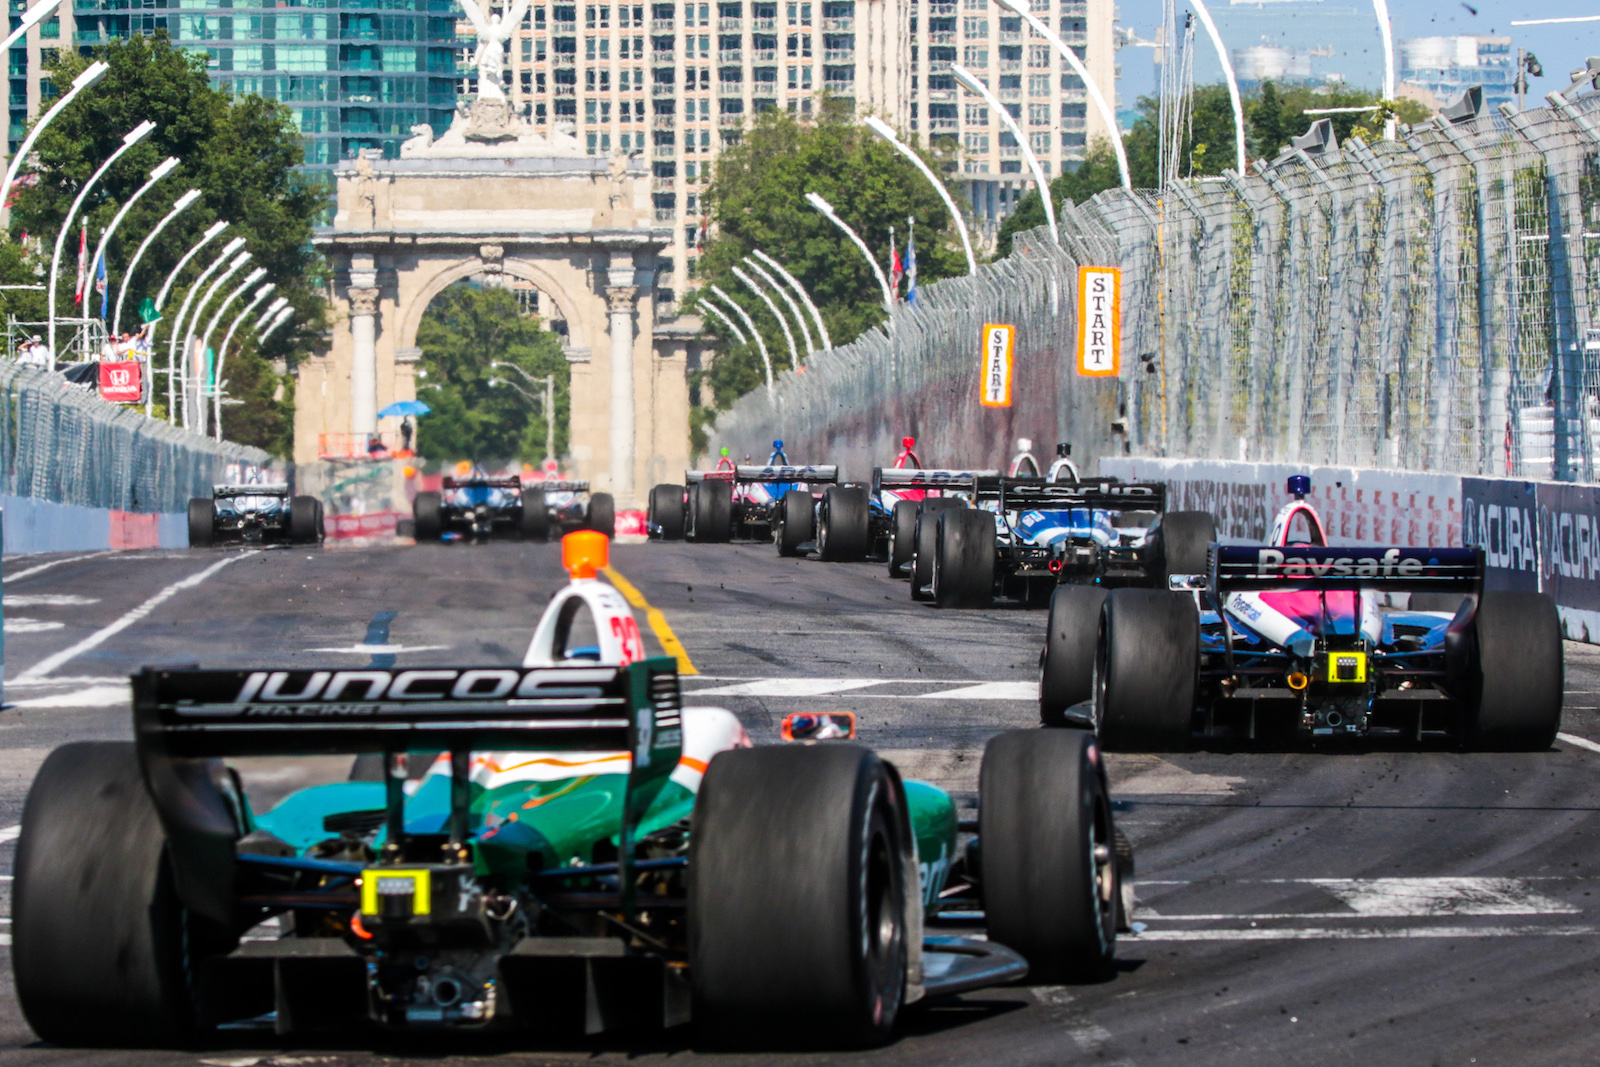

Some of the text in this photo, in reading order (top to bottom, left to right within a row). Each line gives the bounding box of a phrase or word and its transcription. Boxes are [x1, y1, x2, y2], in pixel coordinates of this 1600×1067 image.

[1091, 277, 1106, 364] START
[991, 330, 1003, 400] START
[1012, 483, 1154, 495] carlin
[1257, 548, 1424, 577] Paysafe
[1478, 503, 1536, 572] ACURA
[1551, 511, 1600, 580] ACURA
[228, 670, 618, 706] JUNCOS
